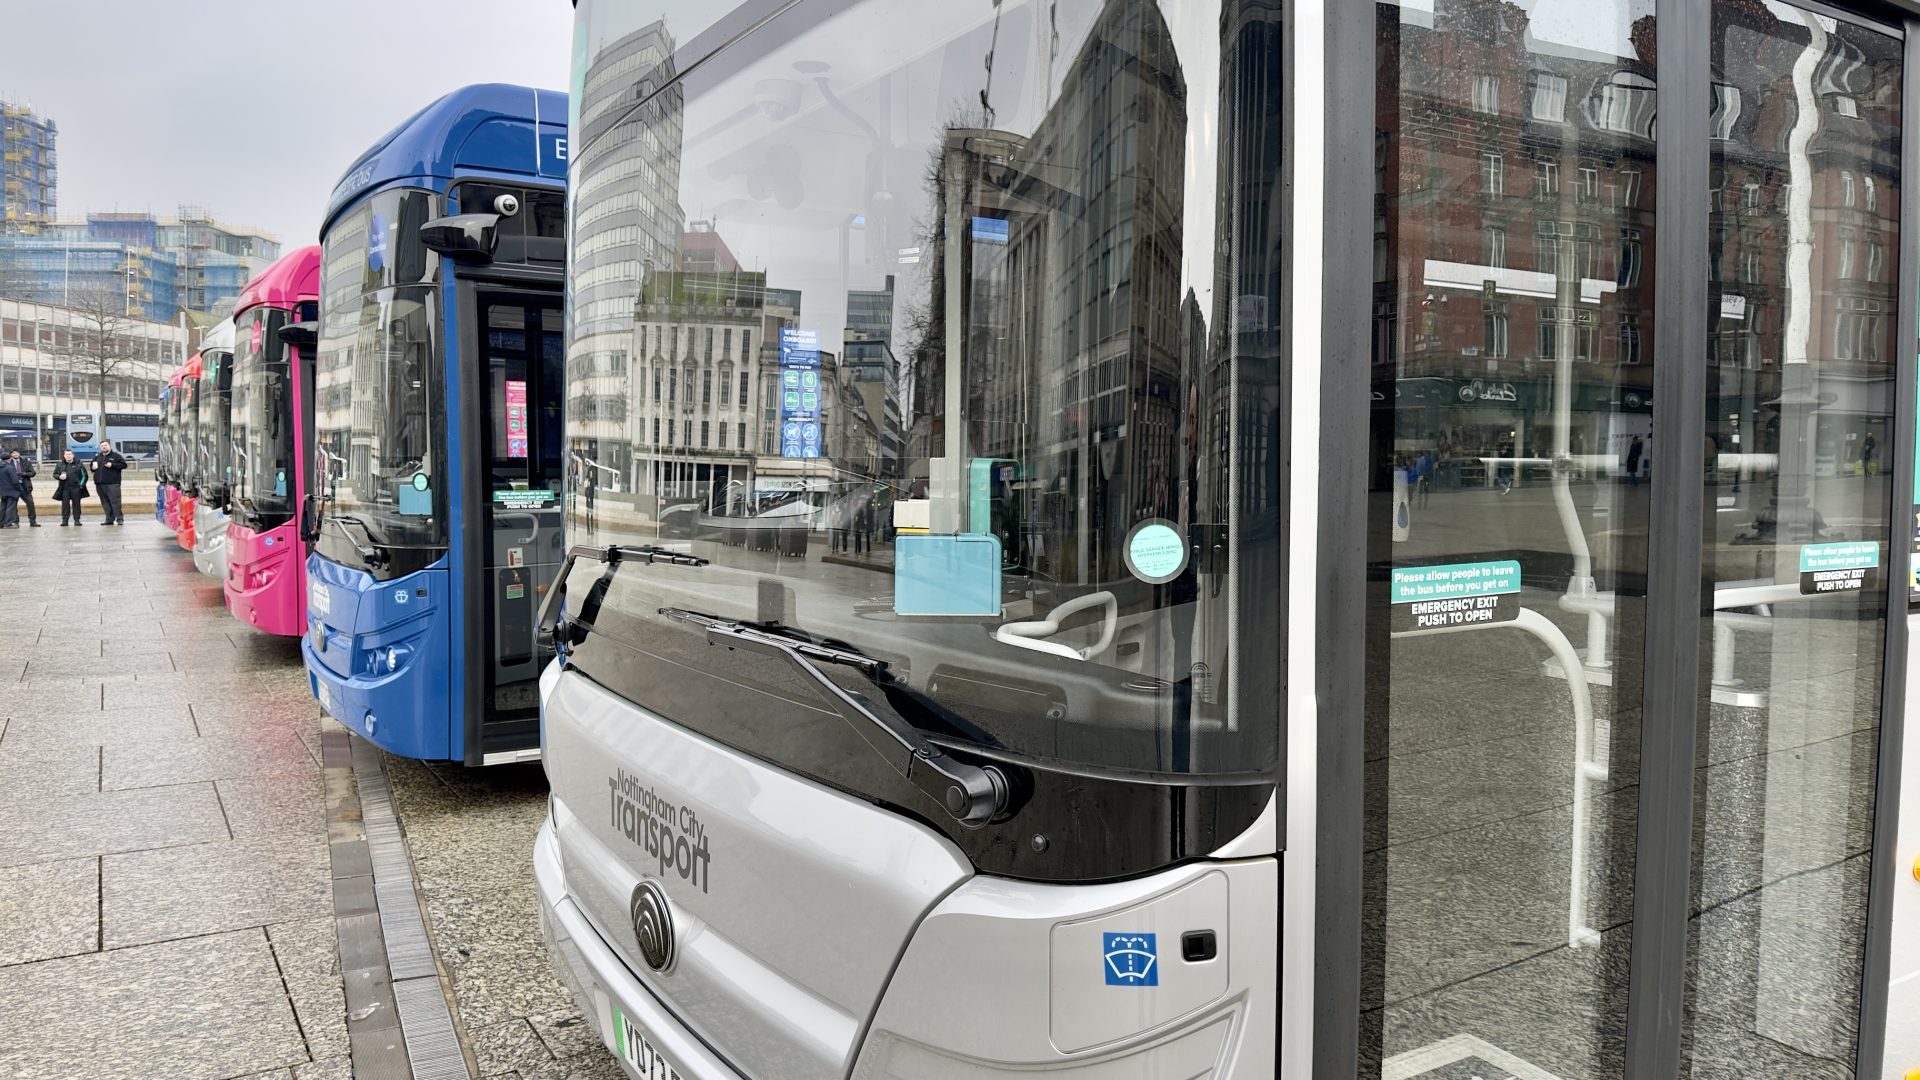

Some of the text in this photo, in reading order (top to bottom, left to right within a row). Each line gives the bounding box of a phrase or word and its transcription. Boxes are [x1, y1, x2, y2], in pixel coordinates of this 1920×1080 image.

[556, 138, 567, 160] E
[1394, 565, 1515, 584] Please allow people to leave
[1813, 568, 1866, 582] EMERGENCY EXIT
[1399, 578, 1509, 597] the bus before you get on
[1816, 578, 1862, 592] PUSH TO OPEN
[1411, 596, 1499, 615] EMERGENCY EXIT
[1418, 608, 1493, 627] PUSH TO OPEN
[618, 767, 704, 850] Nottingham City
[608, 776, 711, 895] Transport
[624, 1017, 682, 1080] YD73
